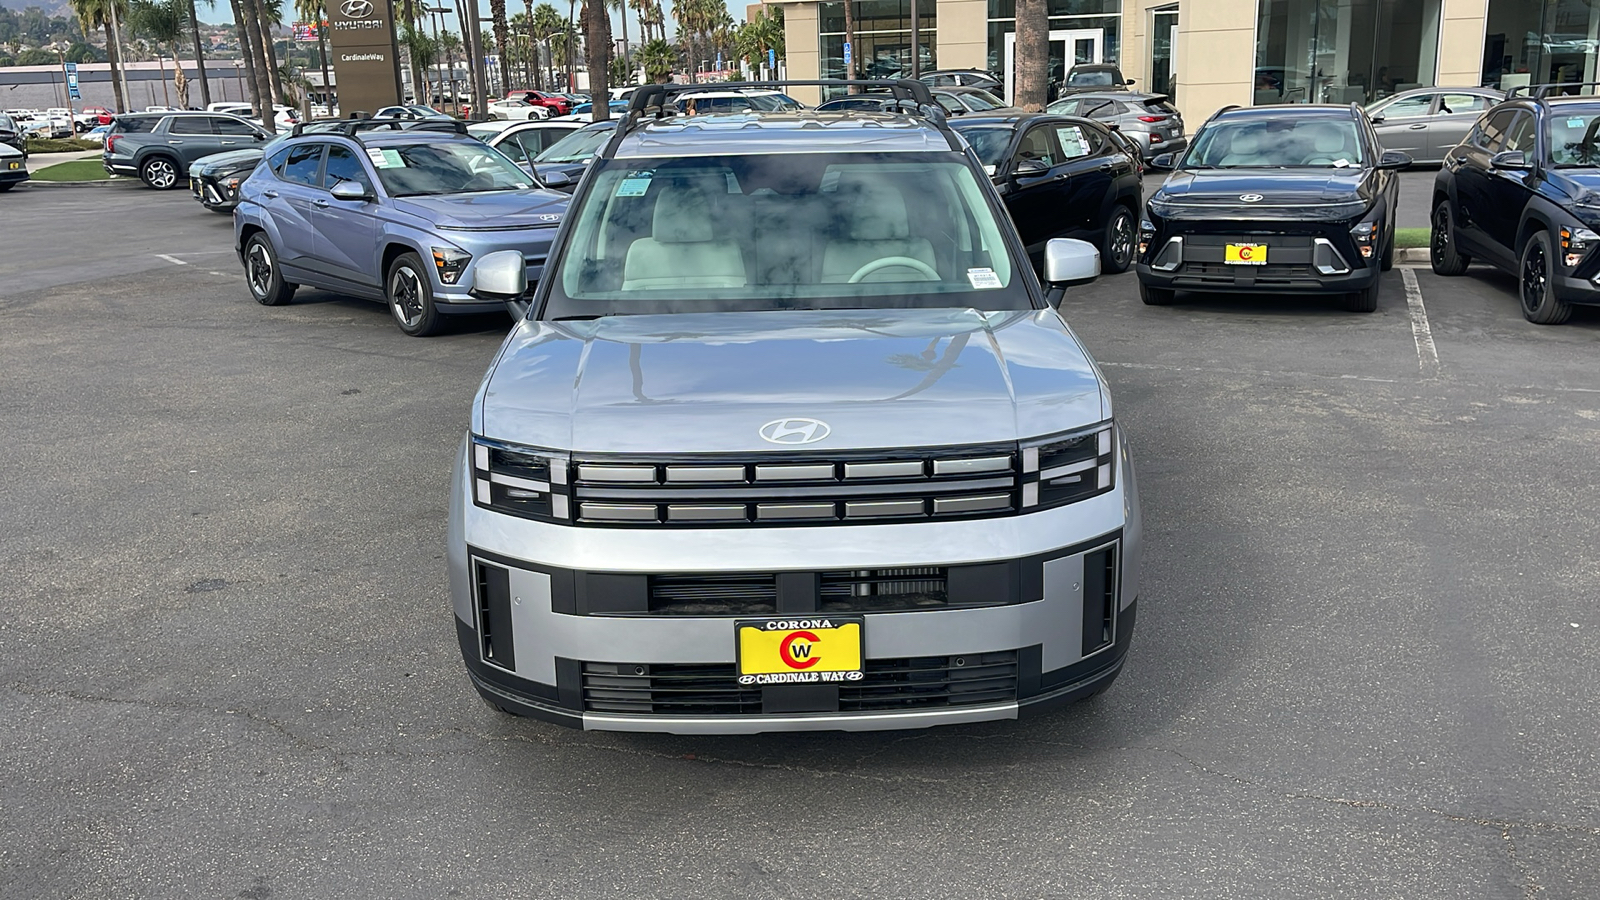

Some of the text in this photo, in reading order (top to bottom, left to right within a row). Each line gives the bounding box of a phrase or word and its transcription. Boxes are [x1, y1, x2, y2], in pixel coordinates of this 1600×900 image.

[334, 20, 383, 30] HYUNDAI
[341, 53, 384, 62] CardinaleWay
[766, 619, 833, 630] CORONA
[756, 671, 846, 684] CARDINALE WAY
